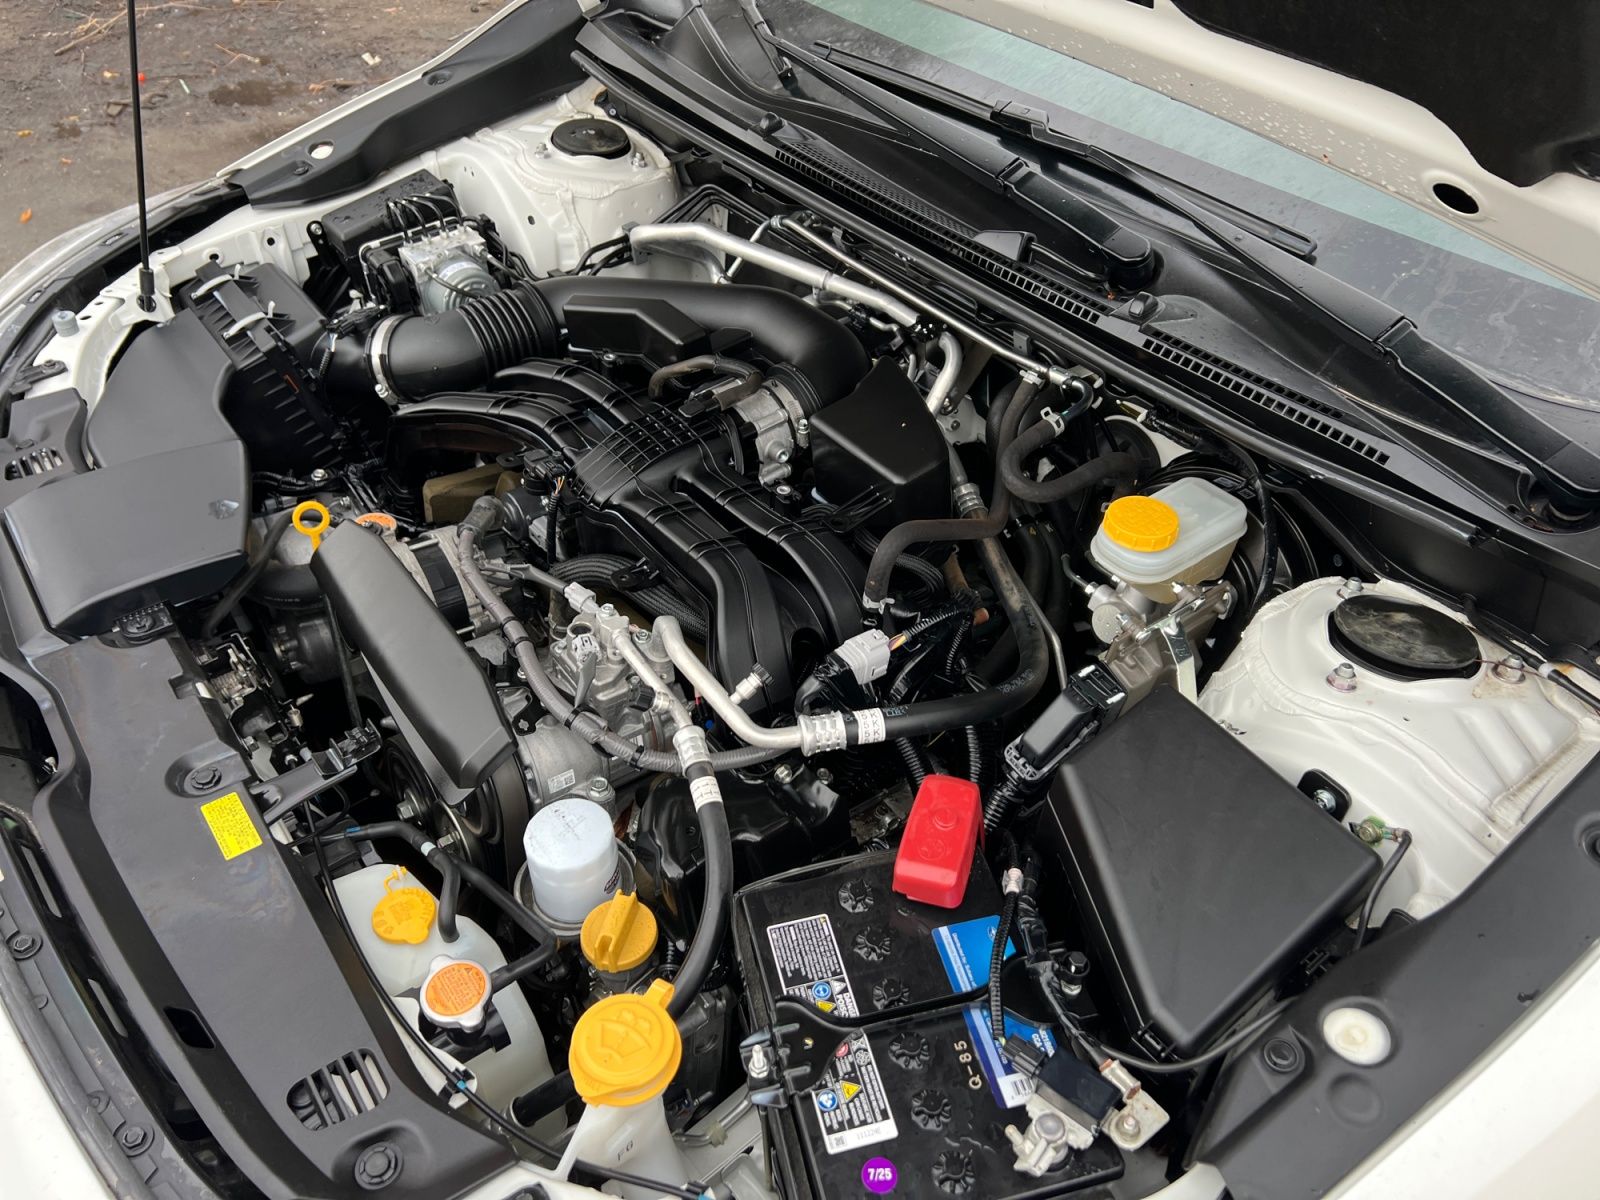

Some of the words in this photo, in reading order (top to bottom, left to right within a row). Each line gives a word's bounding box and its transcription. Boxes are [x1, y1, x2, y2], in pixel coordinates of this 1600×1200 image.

[834, 993, 850, 1018] POISO
[841, 991, 857, 1018] DANGE
[953, 1040, 982, 1090] Q-85
[867, 1167, 893, 1181] 7/25
